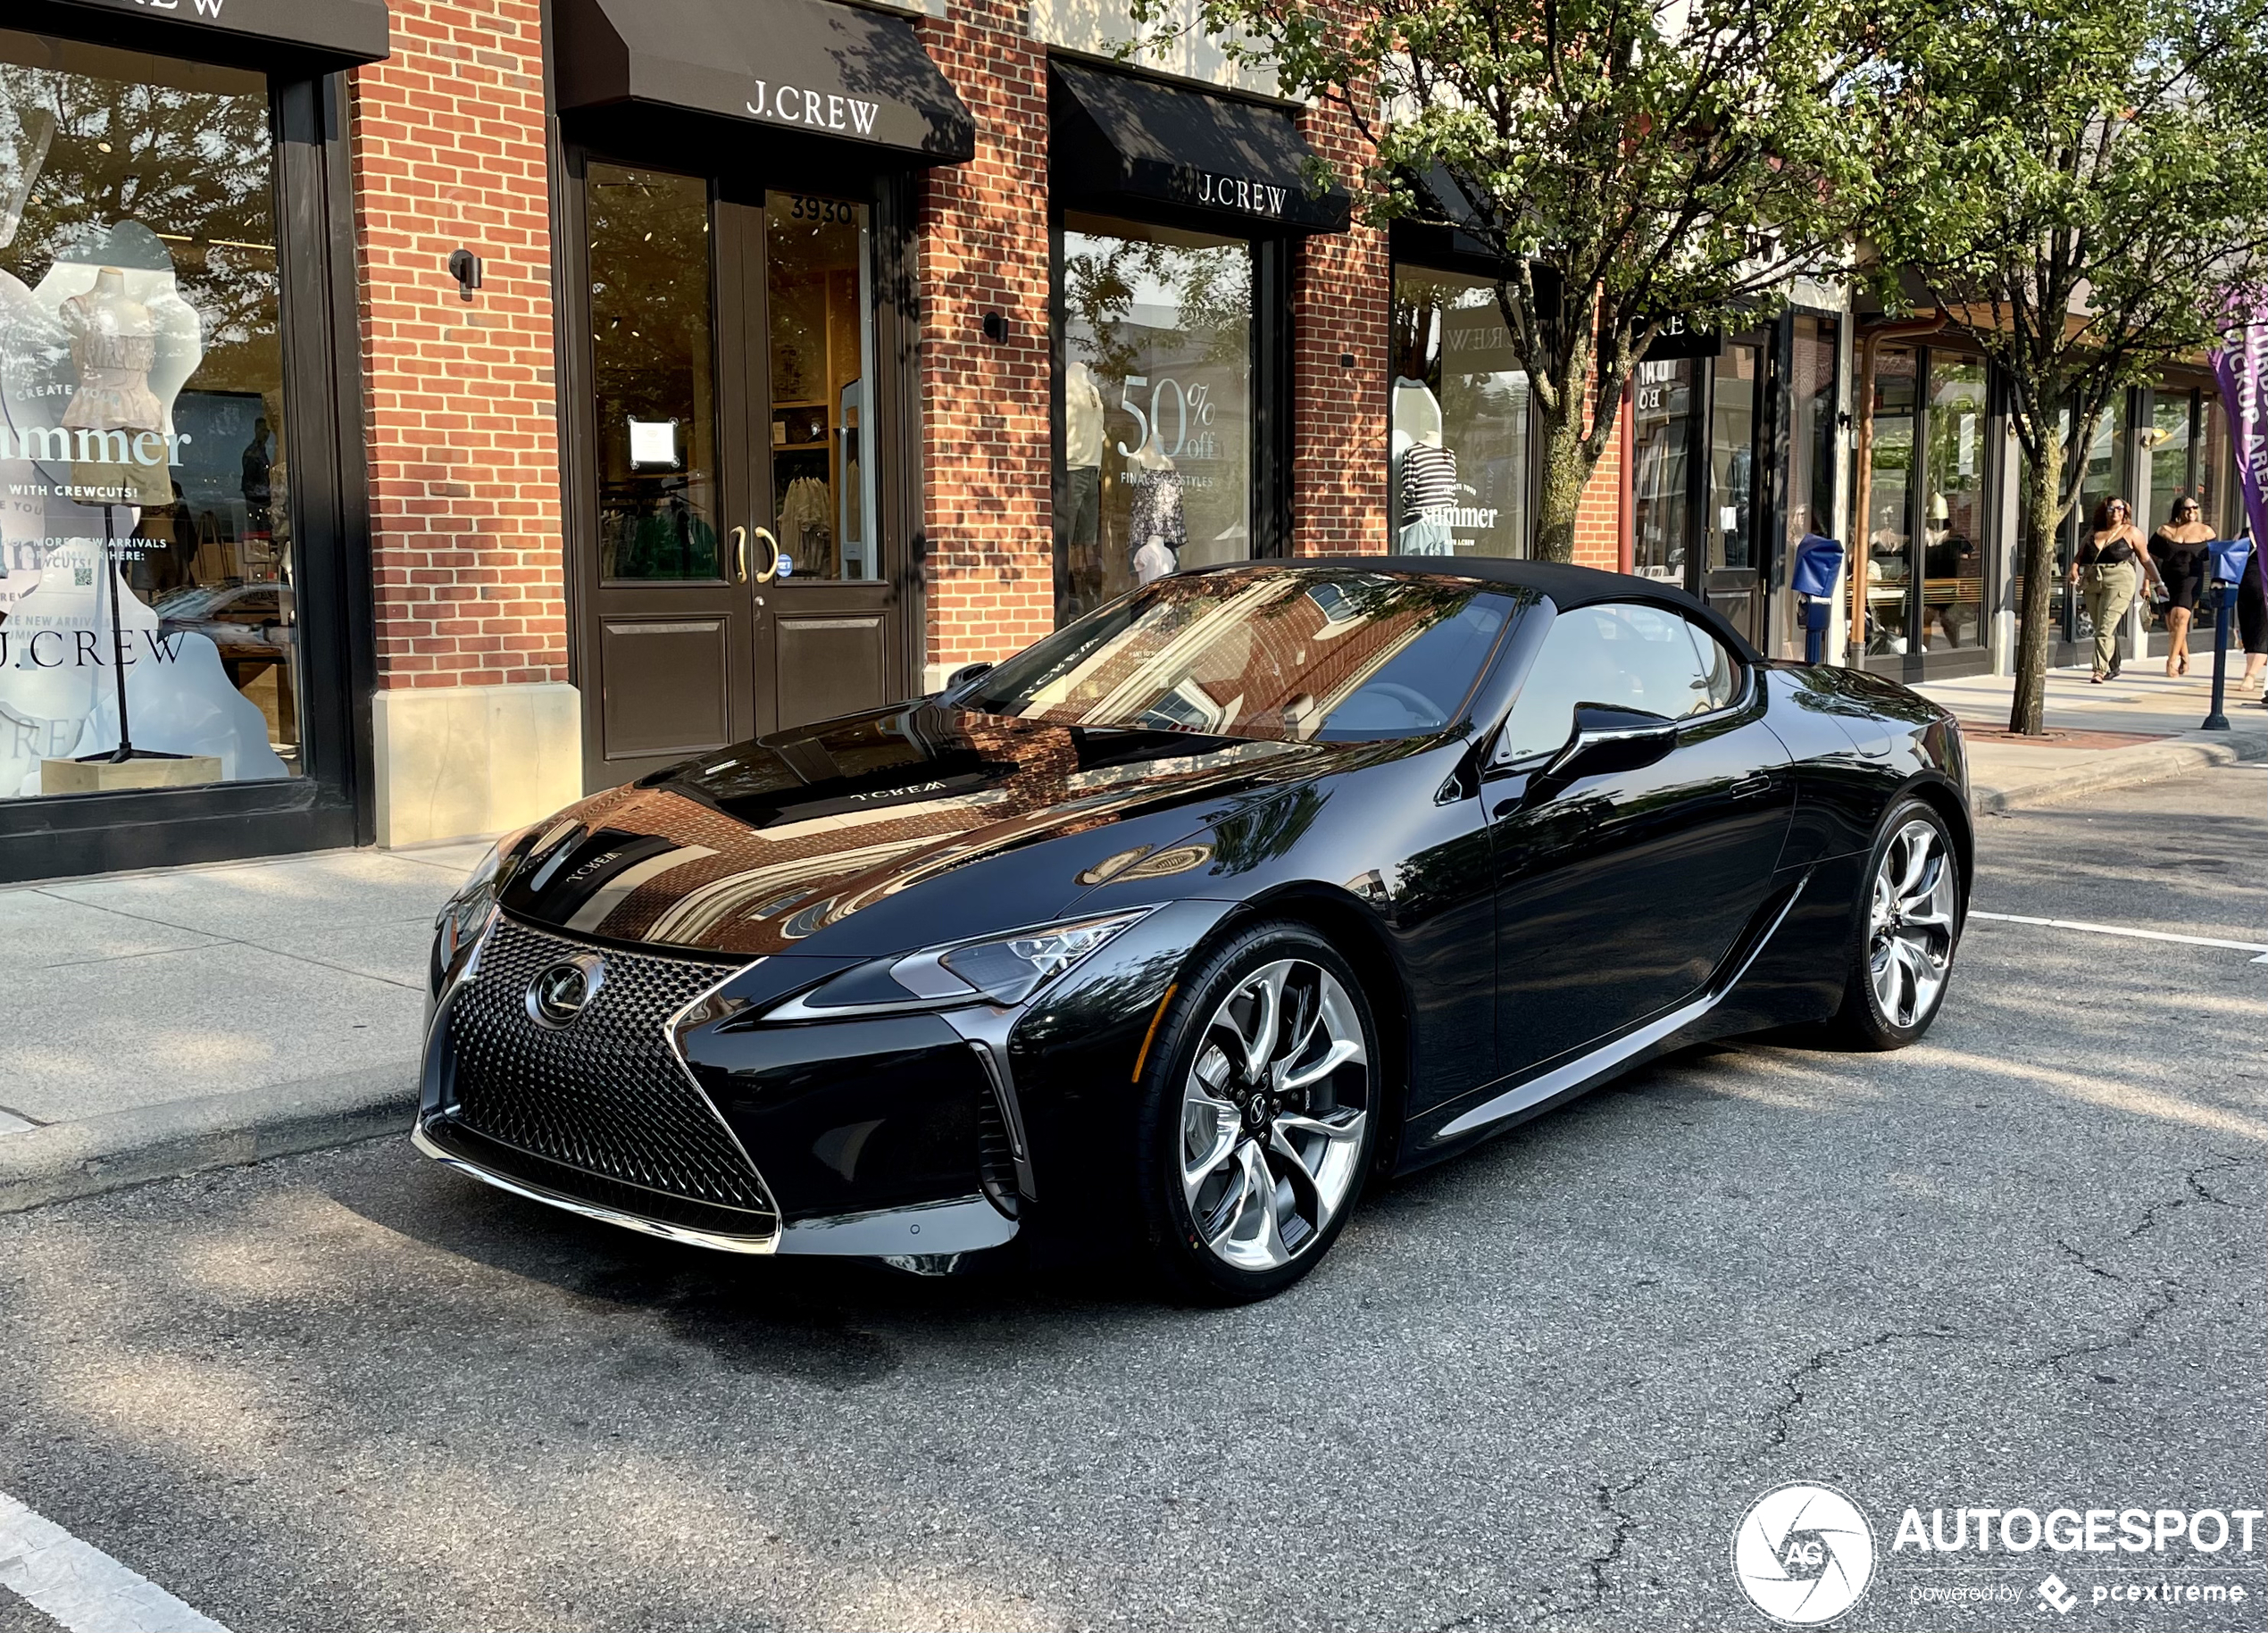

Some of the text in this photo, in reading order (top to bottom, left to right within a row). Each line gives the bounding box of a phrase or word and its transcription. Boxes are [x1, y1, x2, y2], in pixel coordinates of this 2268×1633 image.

[746, 79, 879, 135] J.CREW
[1198, 174, 1287, 215] J.CREW
[790, 195, 853, 225] 3930
[16, 384, 73, 402] CREATE
[1117, 374, 1215, 458] 50%
[1187, 430, 1216, 459] off
[8, 484, 138, 498] WITH CREWCUTS!
[1180, 475, 1213, 487] STYLES
[1421, 506, 1499, 529] summer
[33, 537, 70, 547] MORE
[108, 538, 167, 548] ARRIVALS
[109, 551, 145, 561] HERE:
[0, 629, 187, 670] J.CREW
